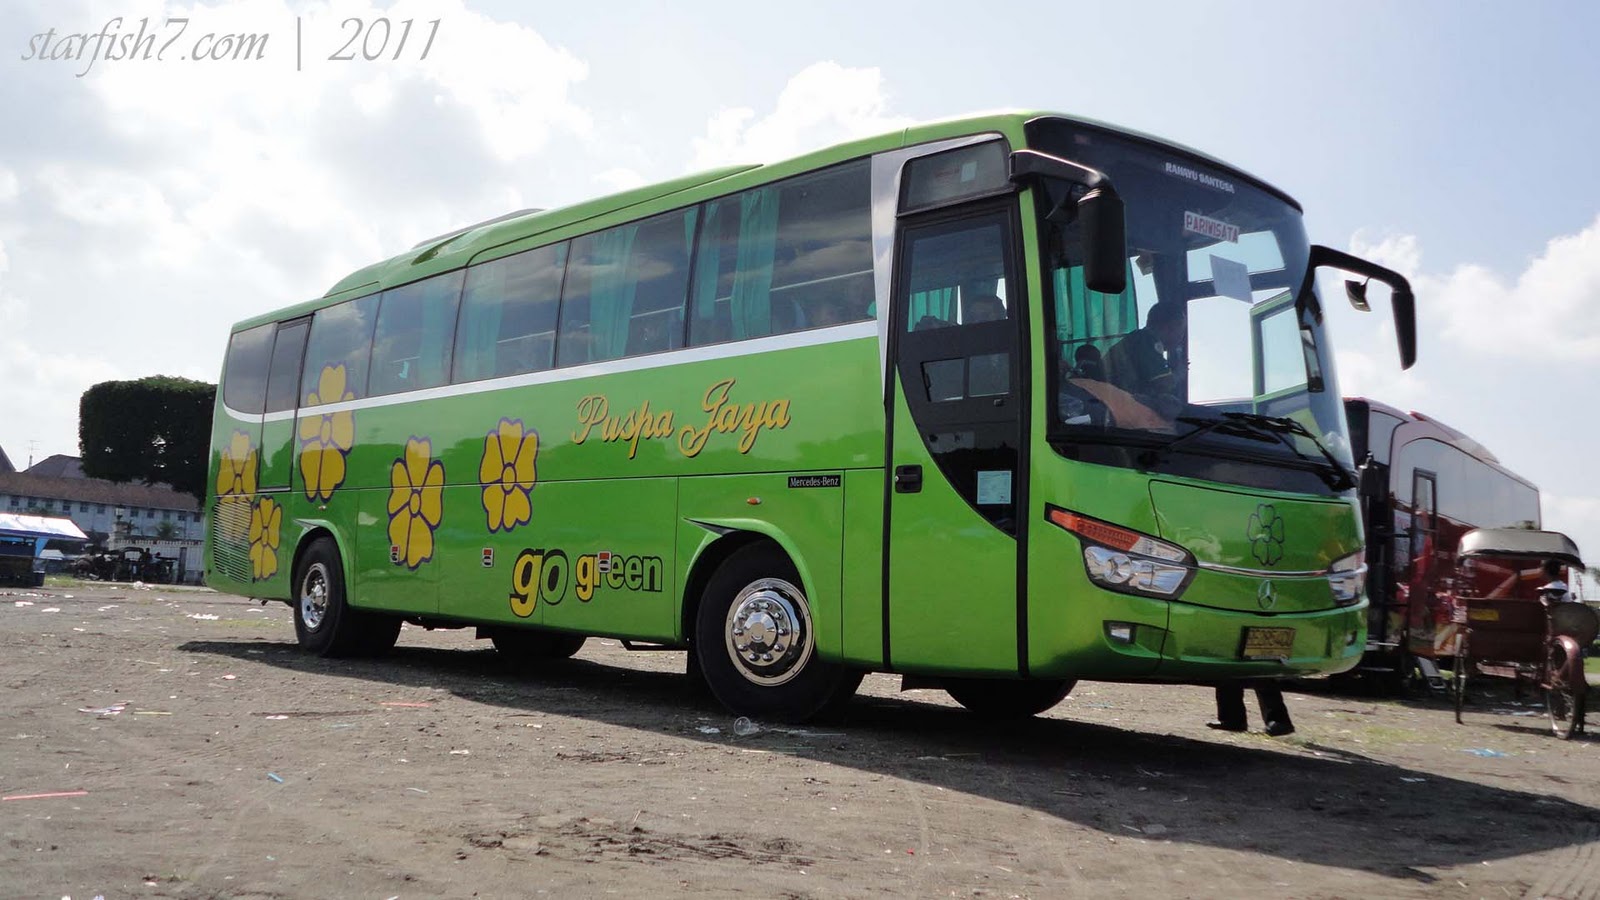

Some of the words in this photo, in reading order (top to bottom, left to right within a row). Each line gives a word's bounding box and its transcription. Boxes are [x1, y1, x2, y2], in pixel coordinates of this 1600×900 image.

[1165, 162, 1198, 180] RAHAYU
[1199, 173, 1235, 193] SANTOSA
[1186, 214, 1239, 243] PARIWISATA
[572, 394, 675, 459] Puspa
[679, 377, 791, 457] Jaya
[790, 476, 840, 487] Mercedes-Benz
[509, 548, 570, 618] go
[575, 553, 664, 603] green
